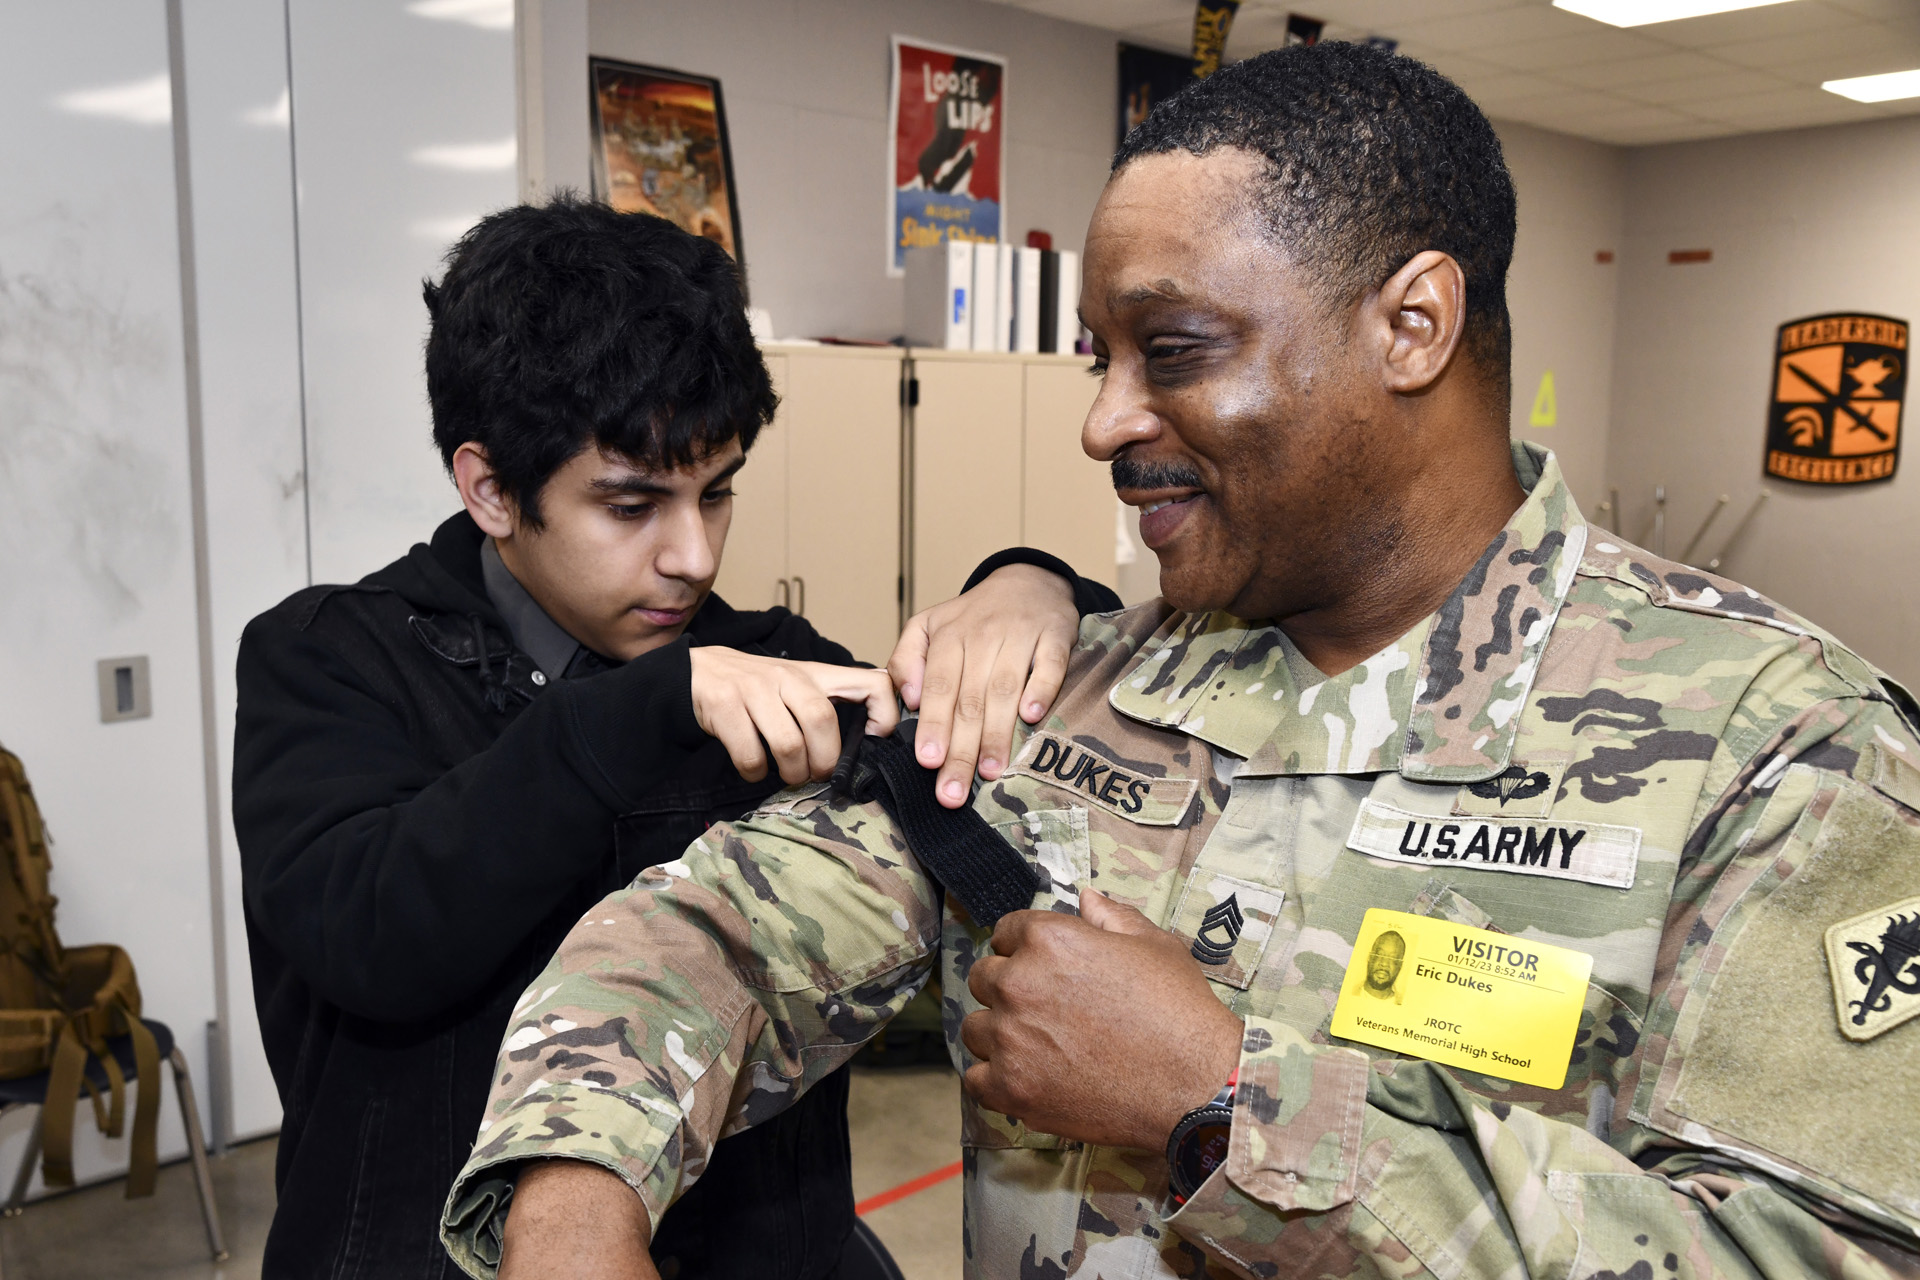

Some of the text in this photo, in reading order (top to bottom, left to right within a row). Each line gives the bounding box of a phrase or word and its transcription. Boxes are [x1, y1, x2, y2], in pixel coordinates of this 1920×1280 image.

[947, 101, 994, 133] LIPS
[1030, 737, 1151, 813] DUKES
[1447, 953, 1536, 983] 01/12/23 8:52 AM
[1452, 935, 1539, 972] VISITOR
[1415, 964, 1493, 994] Eric Dukes
[1423, 1017, 1463, 1035] JROTC
[1356, 1016, 1532, 1069] Veterans Memorial High School
